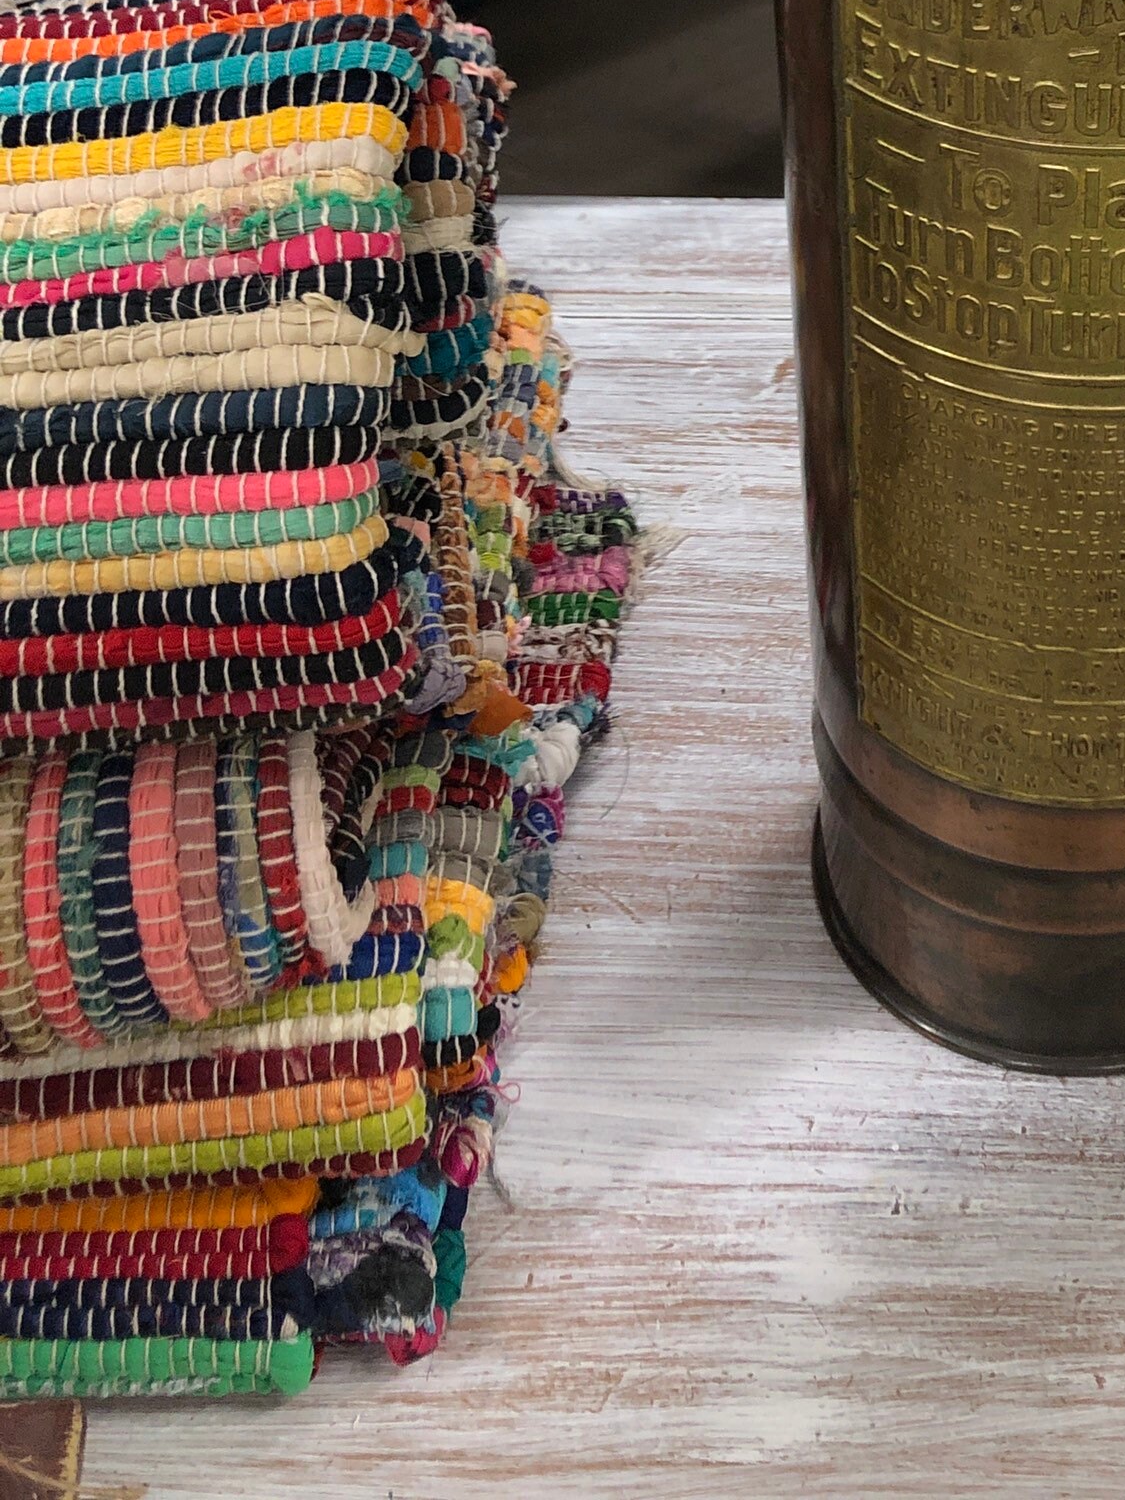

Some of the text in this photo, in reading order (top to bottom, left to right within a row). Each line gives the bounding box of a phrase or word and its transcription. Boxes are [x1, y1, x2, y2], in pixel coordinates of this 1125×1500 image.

[939, 143, 1012, 218] To
[865, 177, 974, 281] Turn
[901, 378, 1040, 441] CHARGING
[868, 660, 973, 745] KNIGHT
